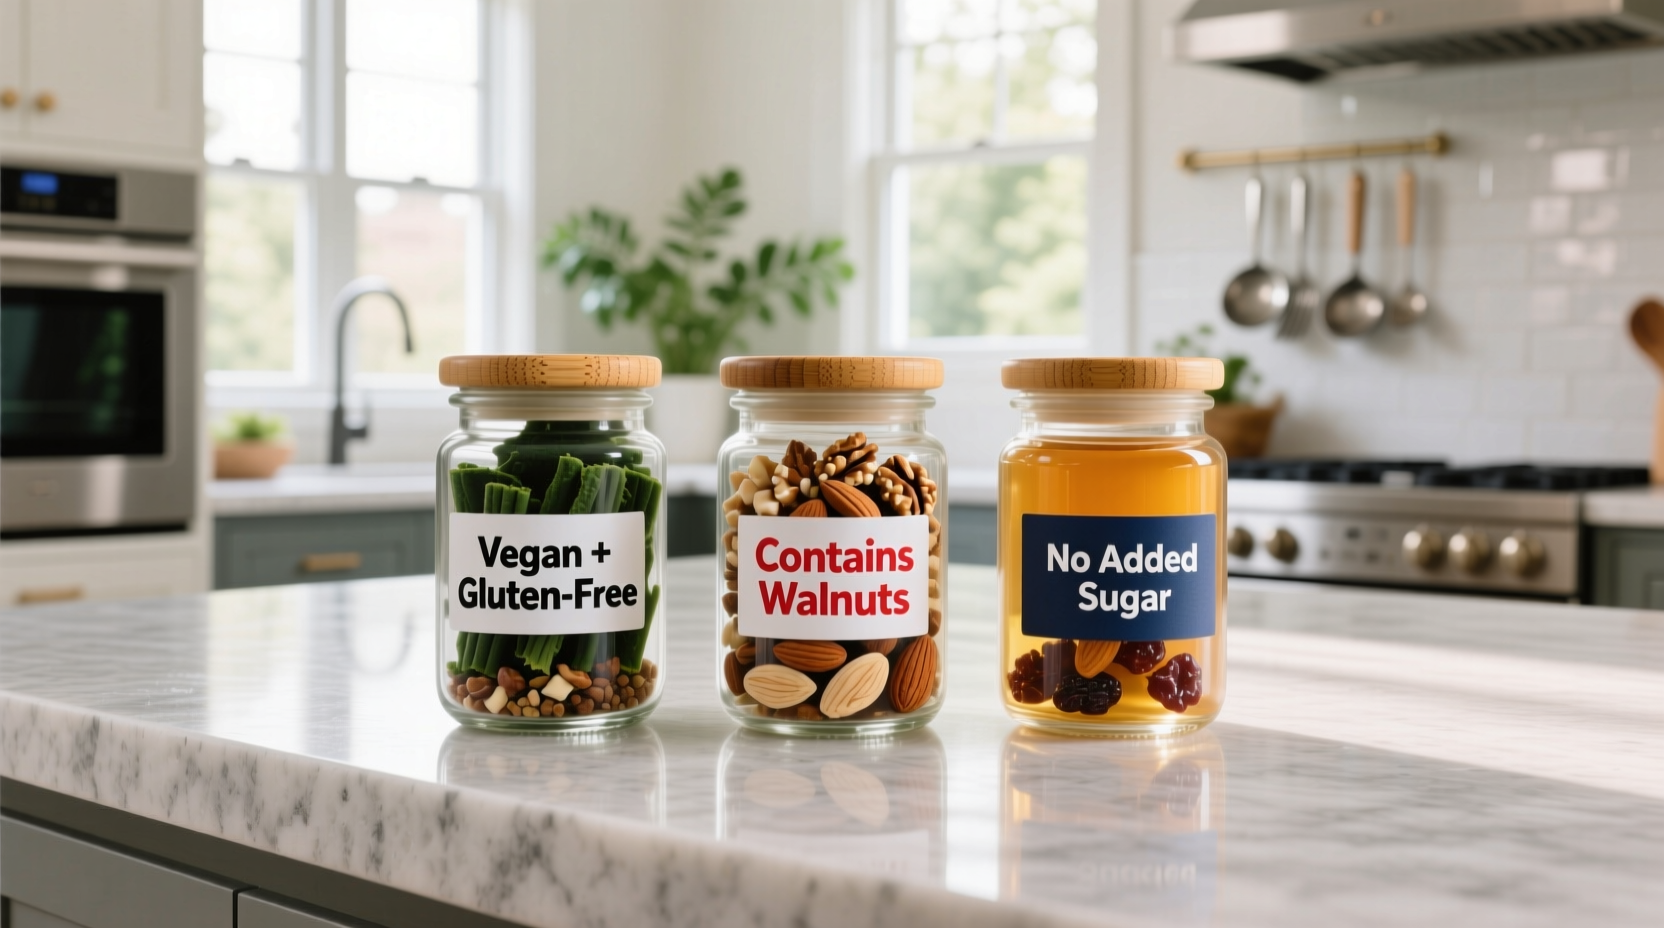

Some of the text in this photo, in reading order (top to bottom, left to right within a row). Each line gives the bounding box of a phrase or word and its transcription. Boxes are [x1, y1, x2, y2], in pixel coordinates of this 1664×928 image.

[477, 535, 611, 577] Vegan +
[754, 536, 915, 574] Contains
[1047, 542, 1198, 574] No Added
[458, 576, 638, 611] Gluten-Free
[758, 580, 911, 617] Walnuts
[1078, 581, 1172, 620] Sugar
